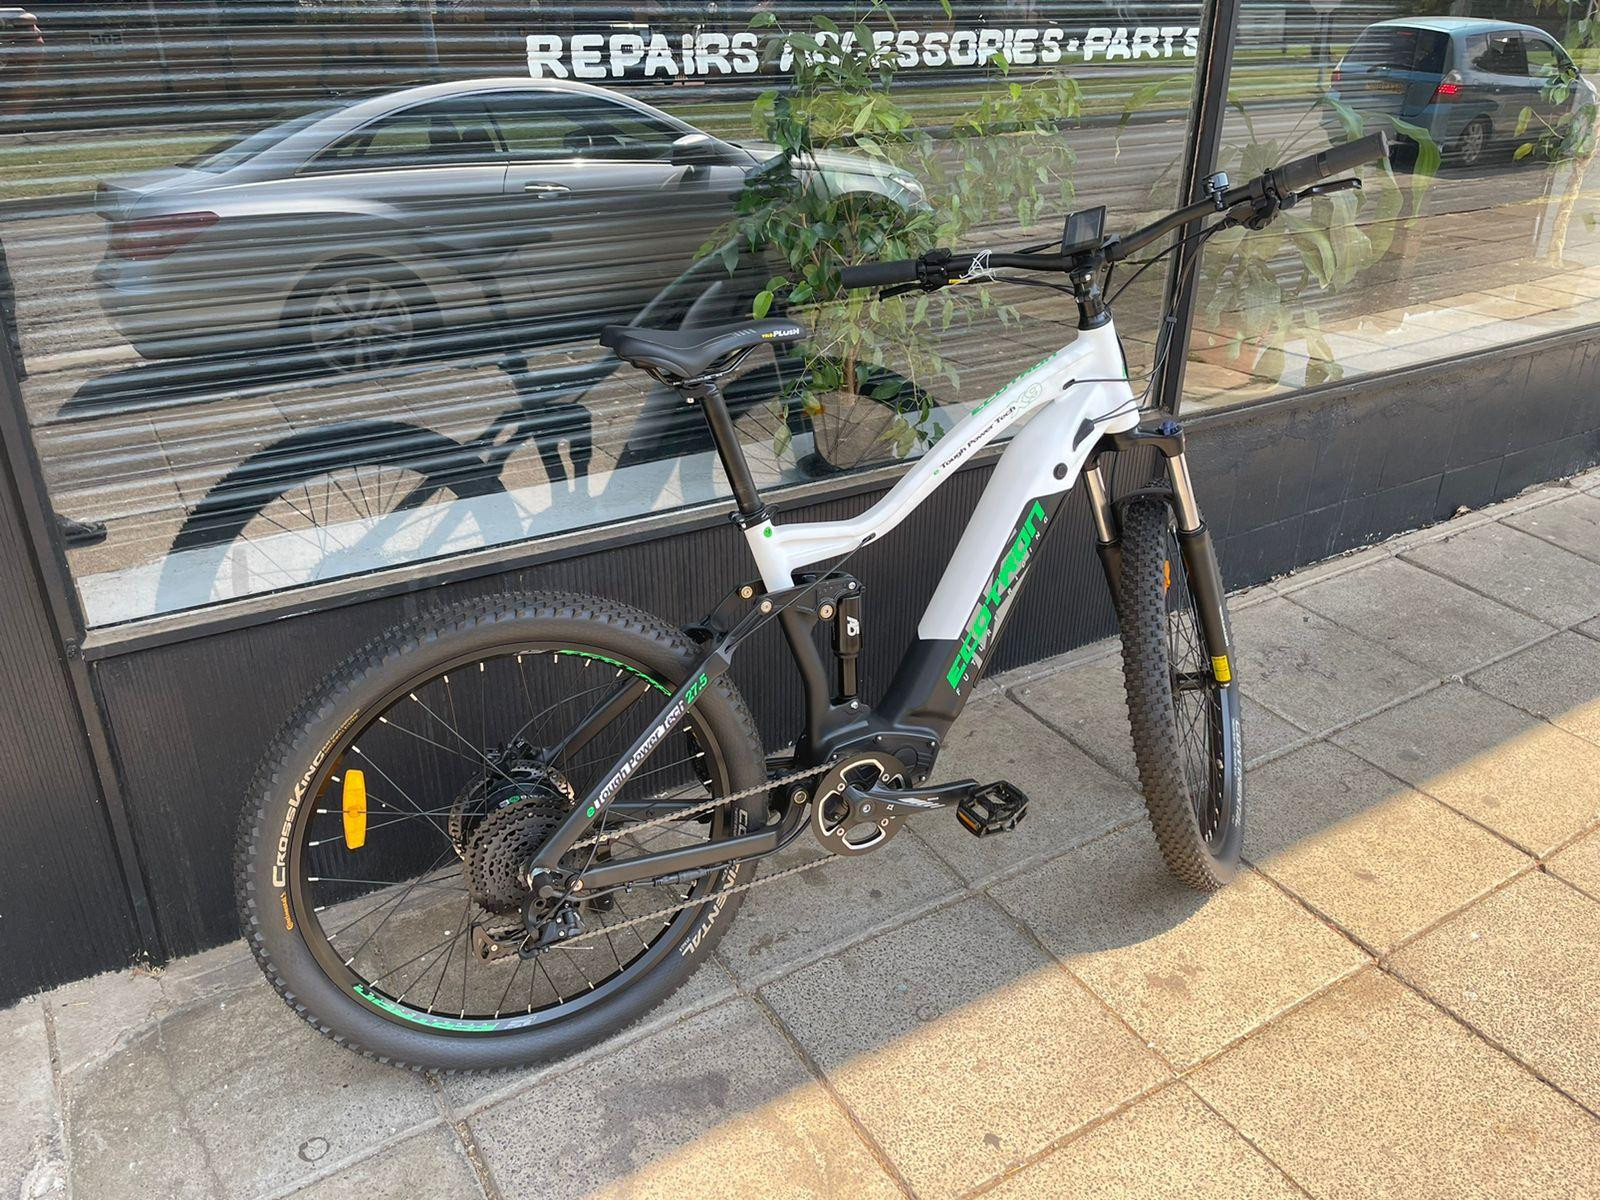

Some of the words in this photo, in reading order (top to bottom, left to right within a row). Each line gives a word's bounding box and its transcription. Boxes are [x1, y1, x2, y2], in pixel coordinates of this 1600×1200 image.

[526, 32, 758, 79] REPAIRS
[1083, 27, 1199, 61] PARTS
[941, 447, 966, 469] Tough
[967, 423, 994, 448] Power
[994, 406, 1016, 424] Tech
[955, 615, 999, 697] FUTURE
[1006, 515, 1049, 597] RIDING
[630, 726, 662, 768] Power
[685, 673, 708, 704] 27.5
[681, 807, 748, 957] COTINENTAL
